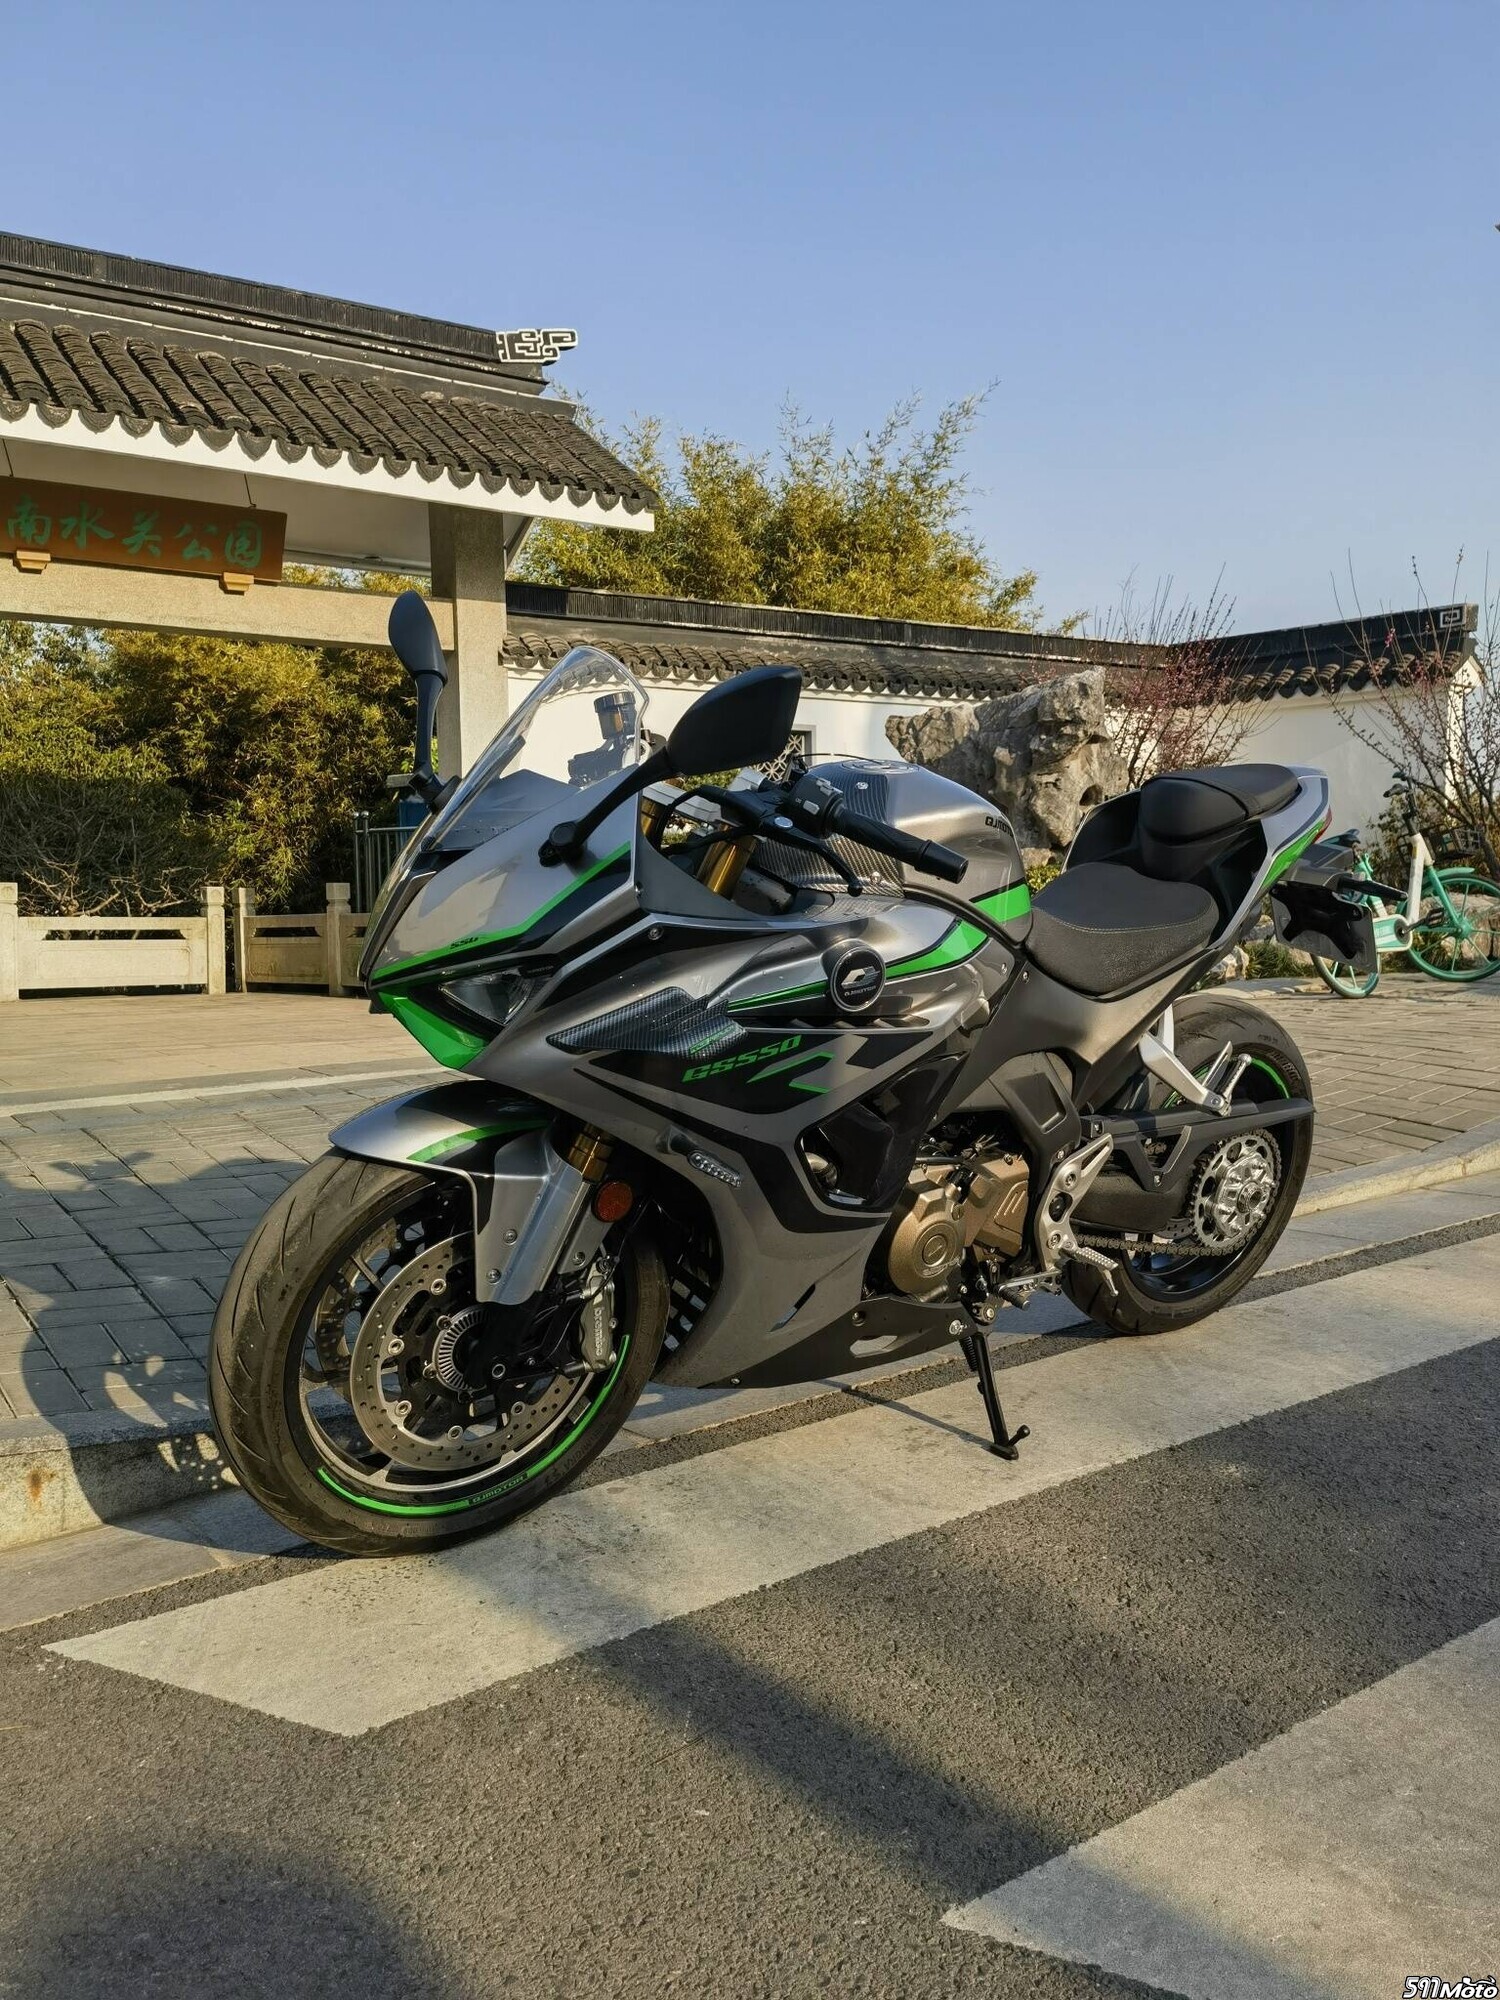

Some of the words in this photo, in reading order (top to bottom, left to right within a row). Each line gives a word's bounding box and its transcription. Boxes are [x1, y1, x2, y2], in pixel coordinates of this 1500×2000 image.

[7, 494, 263, 568] 南水关公园
[682, 1034, 802, 1082] GS550
[594, 1306, 604, 1356] brembo
